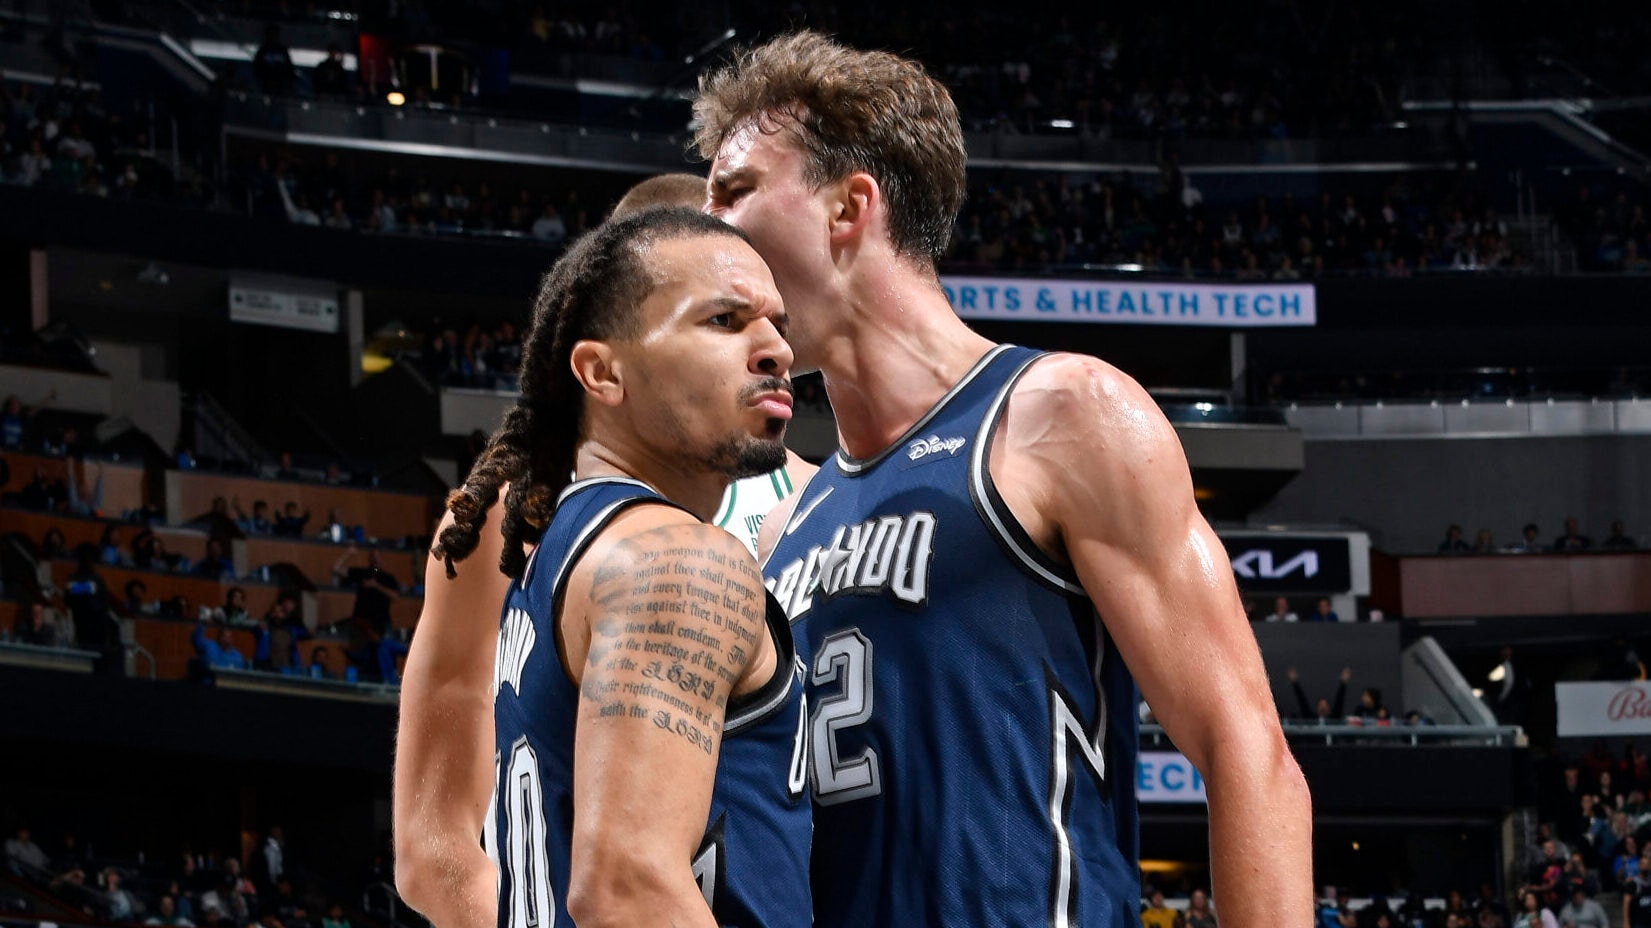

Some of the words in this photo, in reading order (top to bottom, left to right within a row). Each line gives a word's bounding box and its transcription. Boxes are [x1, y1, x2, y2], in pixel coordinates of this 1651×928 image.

[1036, 287, 1057, 312] &
[1071, 289, 1199, 316] HEALTH
[1212, 292, 1300, 318] TECH
[653, 583, 682, 598] every
[646, 600, 688, 615] against
[713, 611, 722, 626] in
